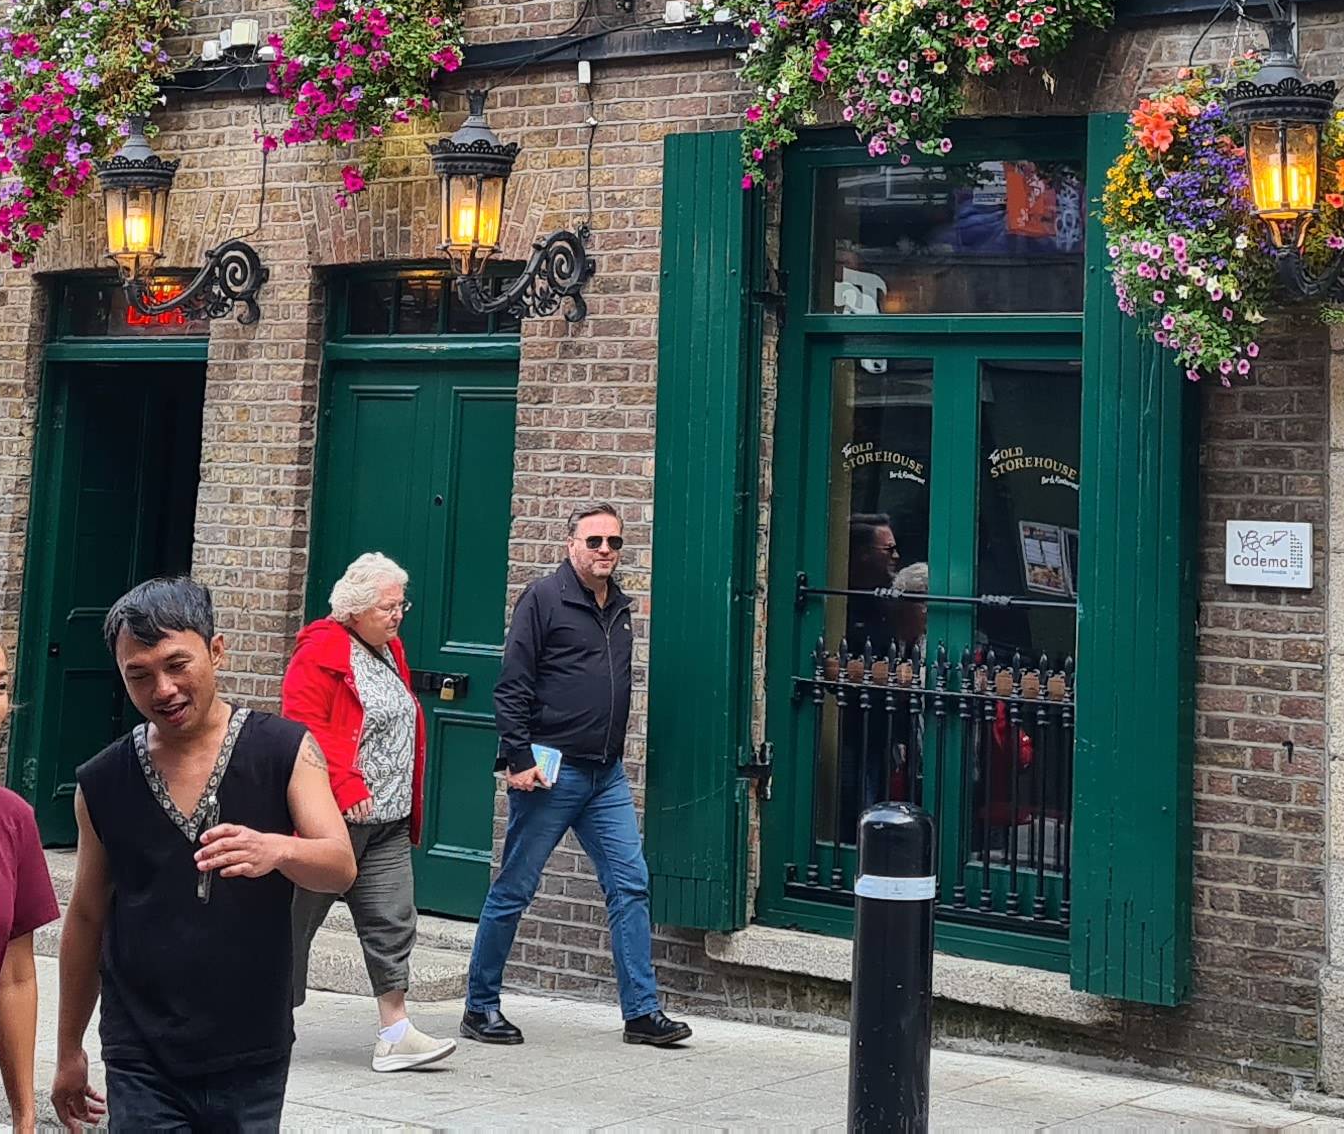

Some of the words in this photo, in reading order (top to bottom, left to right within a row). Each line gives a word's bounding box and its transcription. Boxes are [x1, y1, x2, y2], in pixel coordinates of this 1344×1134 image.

[851, 441, 874, 454] OLD
[1000, 446, 1023, 459] OLD
[842, 450, 924, 475] STOREHOUSE
[990, 456, 1078, 480] STOREHOUSE
[1233, 552, 1288, 568] Codema
